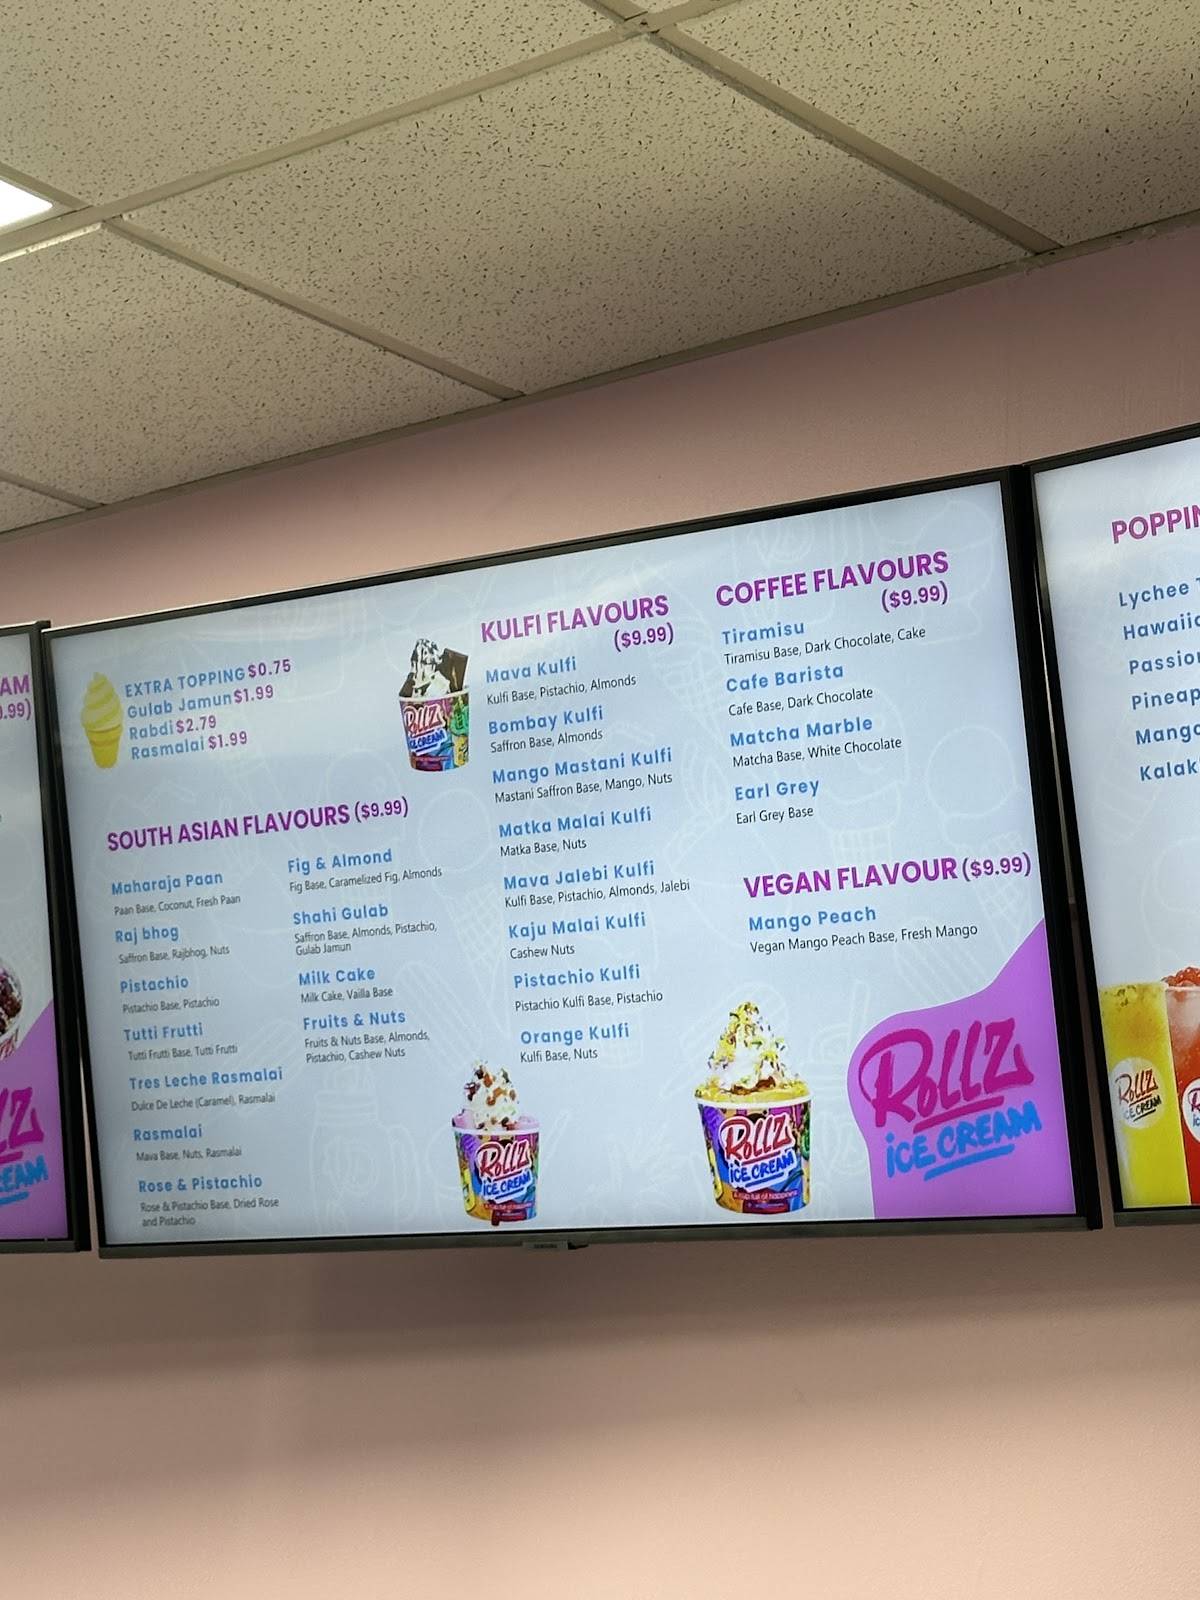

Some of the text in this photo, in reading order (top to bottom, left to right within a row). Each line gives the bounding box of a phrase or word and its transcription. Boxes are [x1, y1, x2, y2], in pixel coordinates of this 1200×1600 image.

[716, 550, 949, 607] COFFEE FLAVOURS
[881, 581, 948, 613] ($9.99)
[1118, 583, 1189, 610] Lychee
[481, 595, 669, 643] KULFI FLAVOURS
[614, 624, 674, 653] ($9.99)
[721, 621, 804, 645] Tiramisu
[723, 626, 926, 665] Tiramisu Base, Dark Chocolate, Cake
[485, 656, 576, 683] Mava Kulfi
[1129, 650, 1200, 675] Passio
[125, 658, 291, 698] EXTRA TOPPING $0.75
[726, 665, 843, 692] Cafe Barista
[127, 684, 274, 718] Gulab Jamun $1.99
[728, 688, 873, 716] Cafe Base, Dark Chocolate
[129, 714, 217, 740] Rabdi $2.79
[488, 704, 603, 735] Bombay Kulfi
[729, 716, 873, 747] Matcha Marble
[131, 730, 248, 760] Rasmalai $1.99
[490, 728, 603, 753] Saffron Base, Almonds
[732, 737, 902, 767] Matcha Base, White Chocolate
[492, 746, 672, 784] Mango Mastani Kulfi
[1140, 759, 1200, 781] Kalak
[494, 773, 673, 803] Mastani Saffron Base, Mango, Nuts
[734, 780, 819, 801] Earl Grey
[107, 795, 409, 851] SOUTH ASIAN FLAVOURS ($9.99)
[498, 806, 651, 838] Matka Malai Kulfi
[287, 848, 392, 876] Fig & Almond
[503, 860, 654, 890] Mava Jalebi Kulfi
[743, 852, 1031, 898] VEGAN FLAVOUR ($9.99)
[111, 873, 223, 895] Maharaja Paan
[289, 881, 303, 895] Fig
[328, 872, 382, 888] Caramelized
[401, 866, 442, 881] Almonds
[504, 879, 690, 908] Kulfi Base, Pistachio, Almonds, Jalebi
[113, 906, 134, 916] Paan
[196, 895, 219, 907] Fresh
[220, 894, 241, 905] Paan
[293, 903, 388, 925] Shahi Gulab
[508, 911, 646, 941] Kaju Malai Kulfi
[748, 906, 876, 933] Mango Peach
[115, 926, 179, 945] Raj bhog
[749, 924, 978, 955] Vegan Mango Peach Base, Fresh Mango
[509, 944, 575, 960] Cashew Nuts
[120, 975, 189, 993] Pistachio
[298, 967, 375, 986] Milk Cake
[513, 963, 640, 989] Pistachio Kulfi
[300, 992, 319, 1003] Milk
[372, 986, 393, 998] Base
[515, 990, 663, 1012] Pistachio Kulfi Base, Pistachio
[123, 1021, 203, 1041] Tutti Frutti
[303, 1010, 406, 1030] Fruits & Nuts
[520, 1022, 629, 1046] Orange Kulfi
[129, 1067, 283, 1090] Tres Leche Rasmalai
[131, 1100, 154, 1112] Dulce
[155, 1099, 168, 1110] De
[169, 1098, 194, 1109] Leche
[238, 1092, 276, 1105] Rasmalai
[1136, 1094, 1162, 1115] CREAM
[133, 1123, 202, 1141] Rasmalai
[937, 1100, 1042, 1159] CREAM
[752, 1150, 795, 1179] CREAM
[138, 1173, 263, 1193] Rose & Pistachio
[501, 1172, 531, 1193] CREAM
